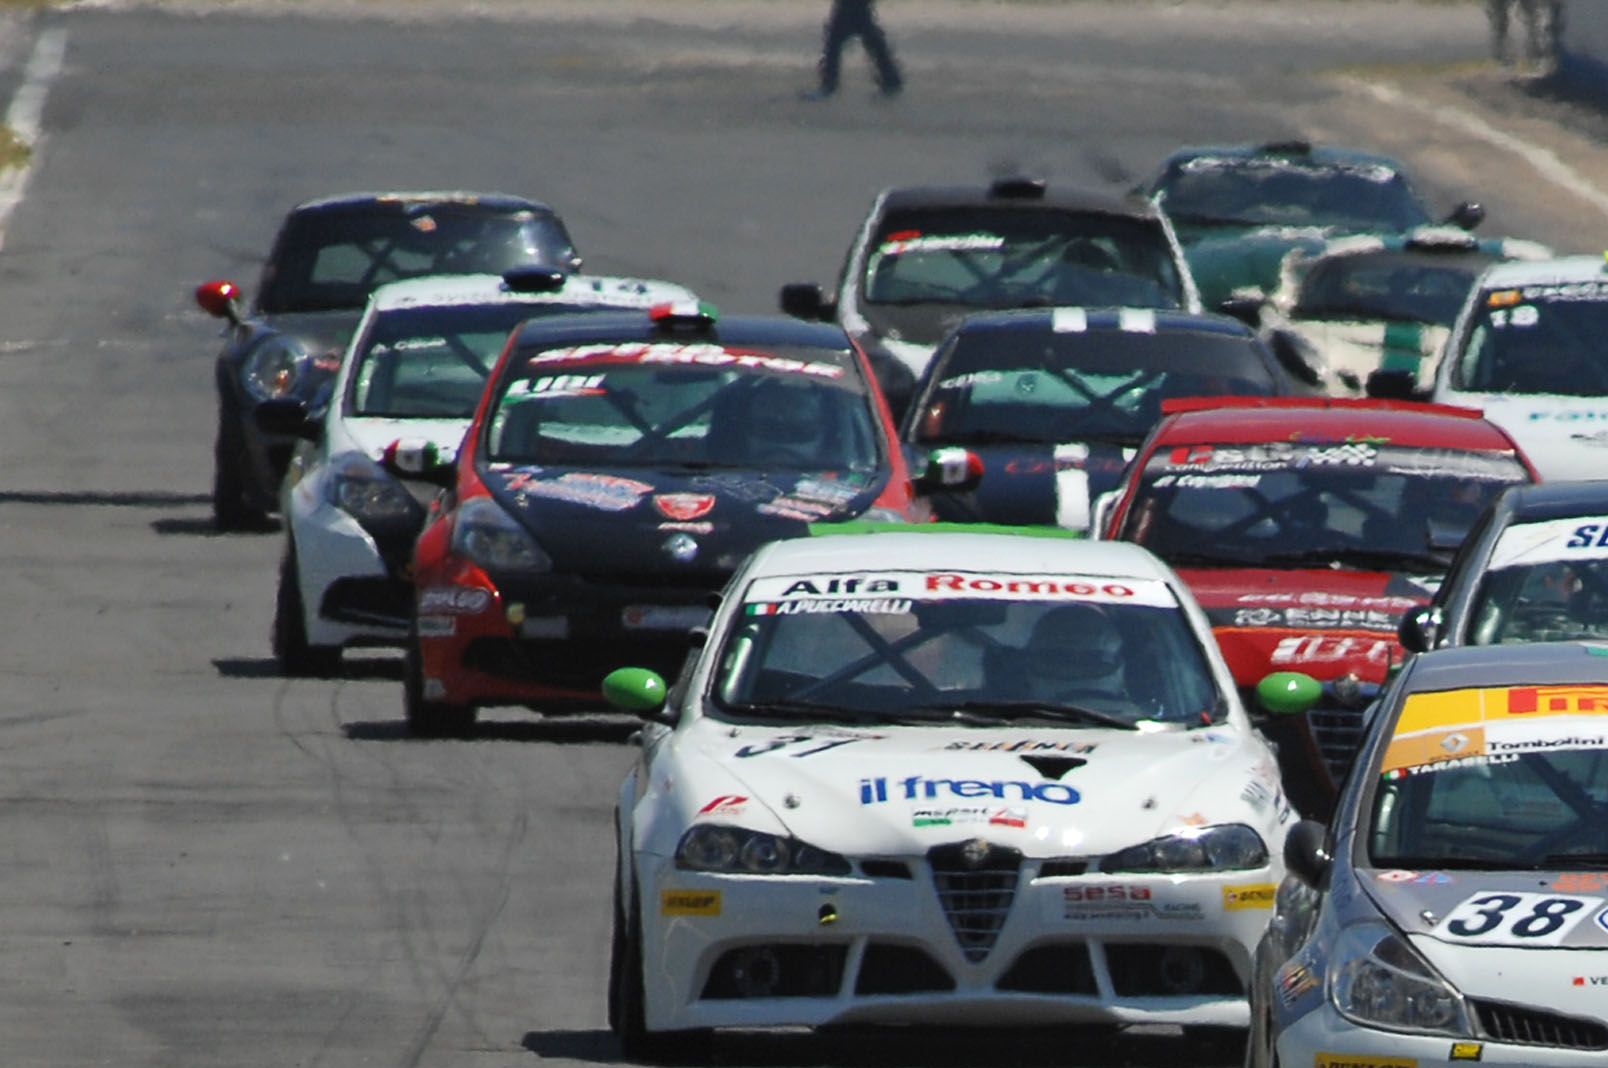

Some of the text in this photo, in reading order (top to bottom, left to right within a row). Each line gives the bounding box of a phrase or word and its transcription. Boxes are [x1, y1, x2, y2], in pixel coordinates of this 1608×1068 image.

[781, 573, 1136, 598] Alfa Romeo
[1488, 729, 1605, 752] Tombolini
[859, 775, 1082, 806] il freno
[1063, 884, 1152, 901] sesa
[1447, 894, 1585, 938] 38
